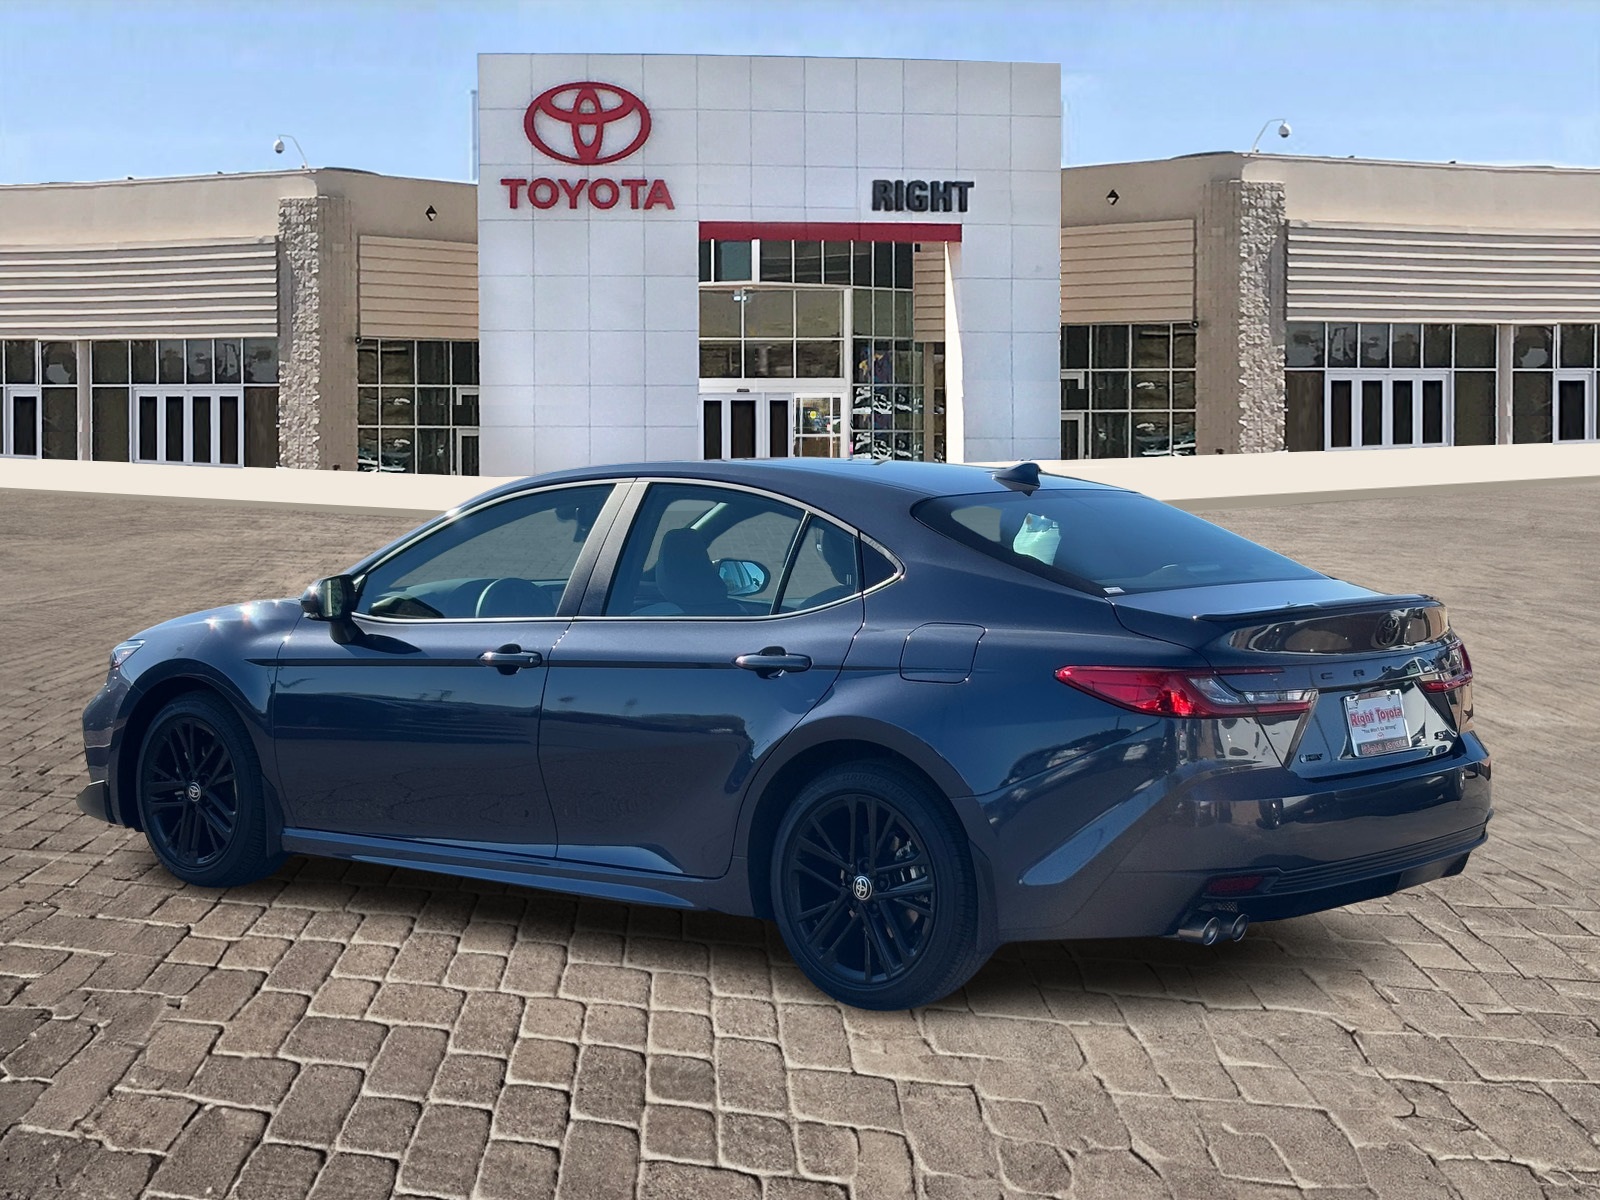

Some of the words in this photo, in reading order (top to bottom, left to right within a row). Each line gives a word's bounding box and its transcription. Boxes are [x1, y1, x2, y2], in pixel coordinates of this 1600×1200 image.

[500, 178, 675, 210] TOYOTA
[872, 179, 975, 212] RIGHT
[1350, 709, 1375, 729] Right
[1374, 704, 1402, 724] Toyota
